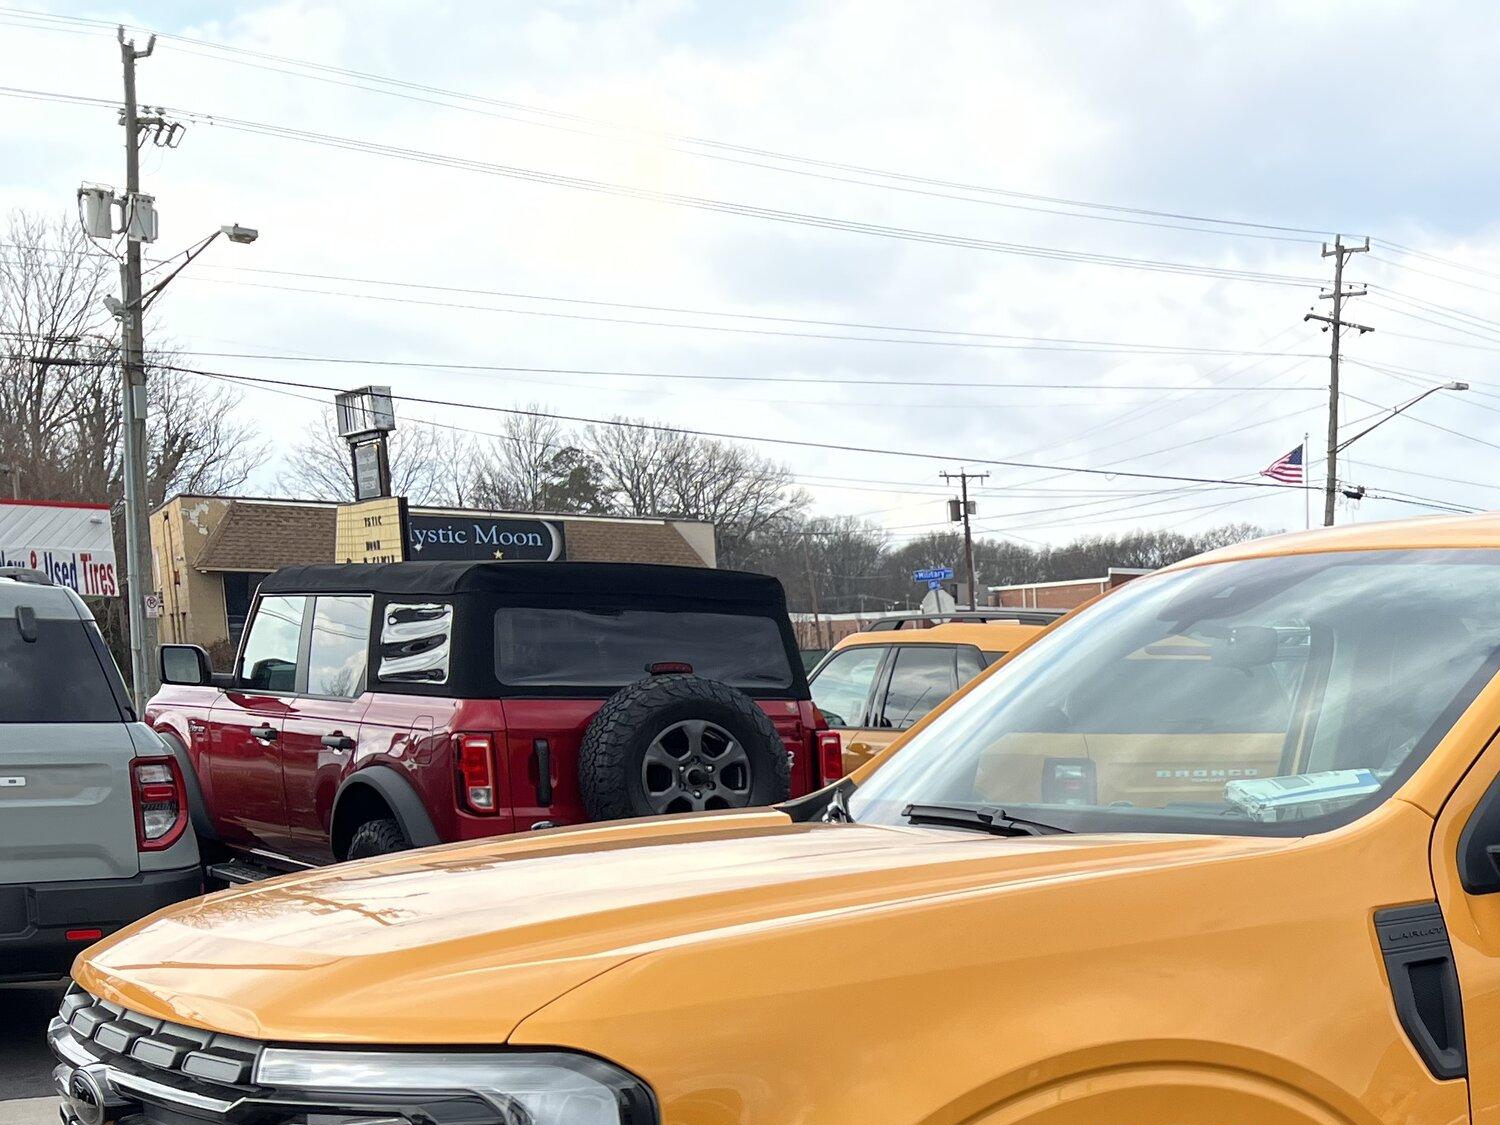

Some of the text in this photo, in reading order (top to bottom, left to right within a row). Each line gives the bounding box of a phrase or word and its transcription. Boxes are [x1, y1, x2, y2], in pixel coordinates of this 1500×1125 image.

[409, 522, 543, 546] ystic Moon
[80, 553, 116, 596] Tires
[1156, 768, 1258, 778] BRONCO
